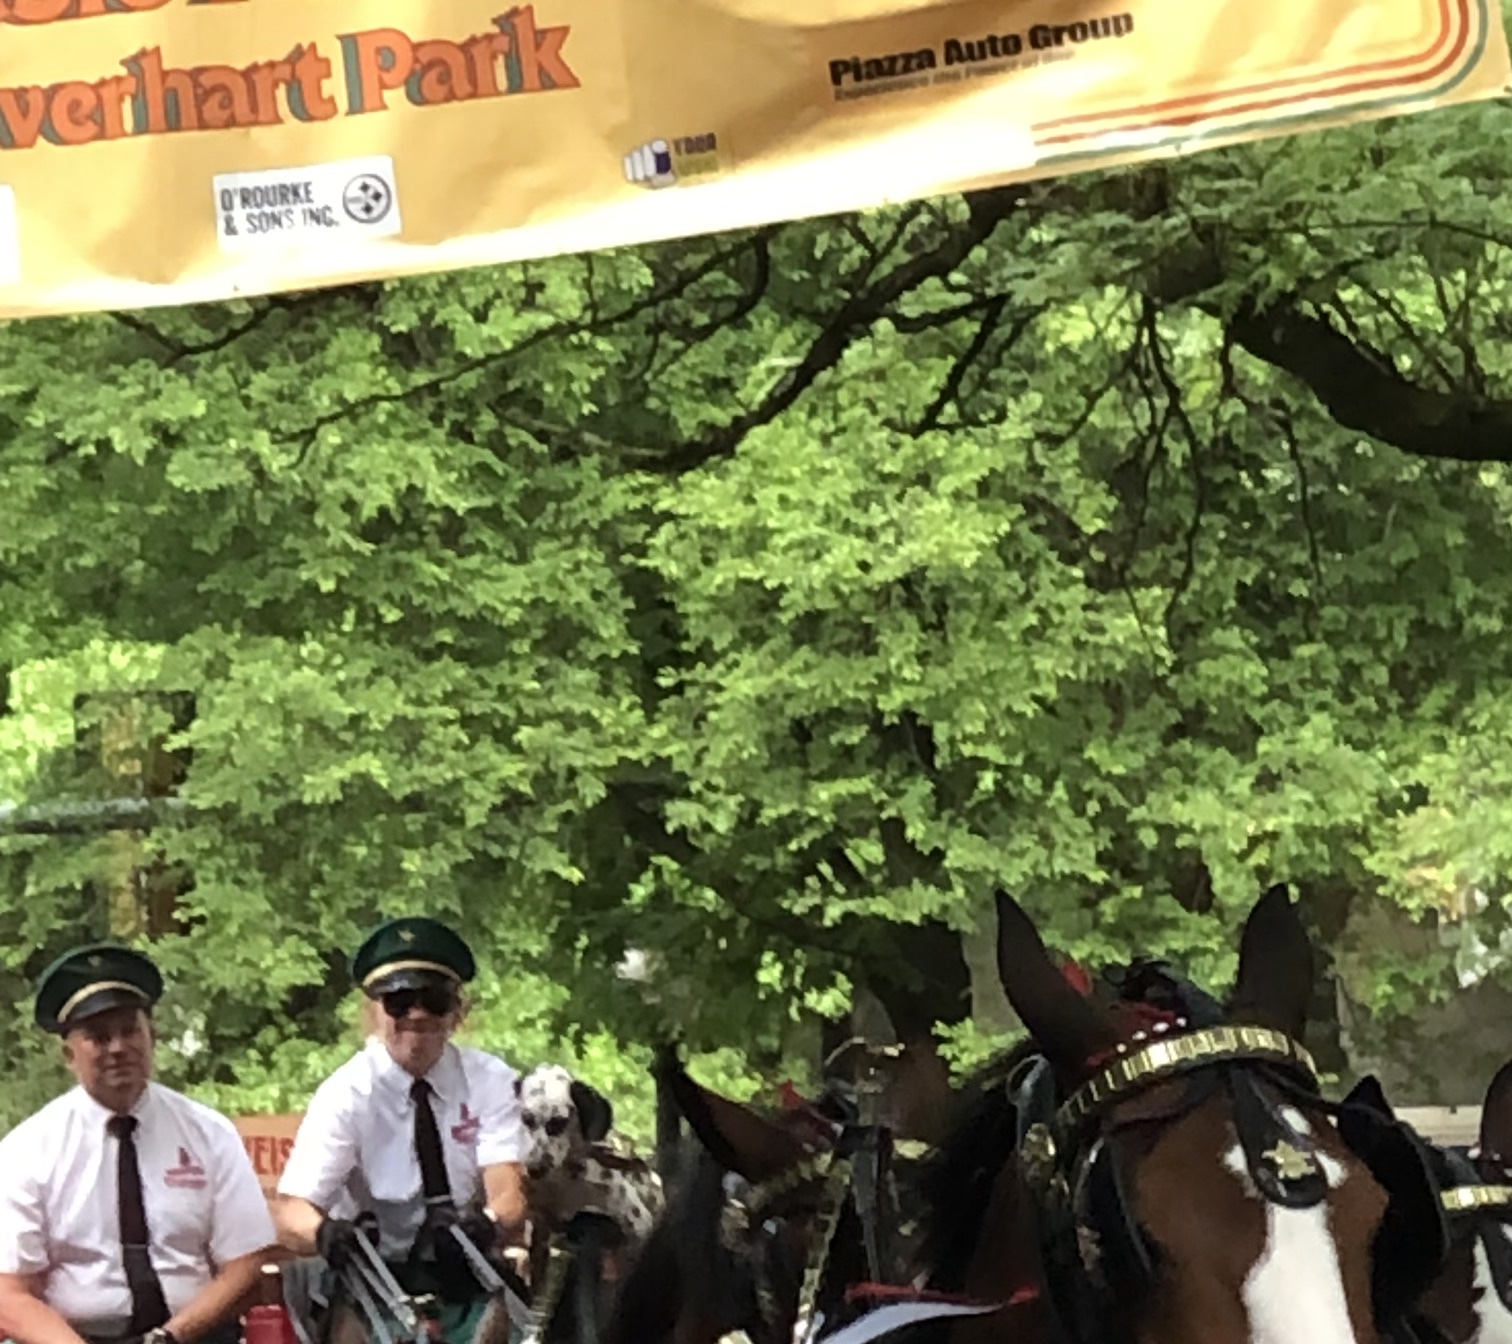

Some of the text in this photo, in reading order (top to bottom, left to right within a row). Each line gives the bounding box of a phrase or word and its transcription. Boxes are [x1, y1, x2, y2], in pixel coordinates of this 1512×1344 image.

[335, 4, 582, 116] Park
[828, 48, 937, 86] Piazza
[943, 34, 1023, 66] Auto
[1028, 12, 1134, 51] Group
[220, 181, 315, 212] O'ROURKE
[223, 213, 239, 236] &
